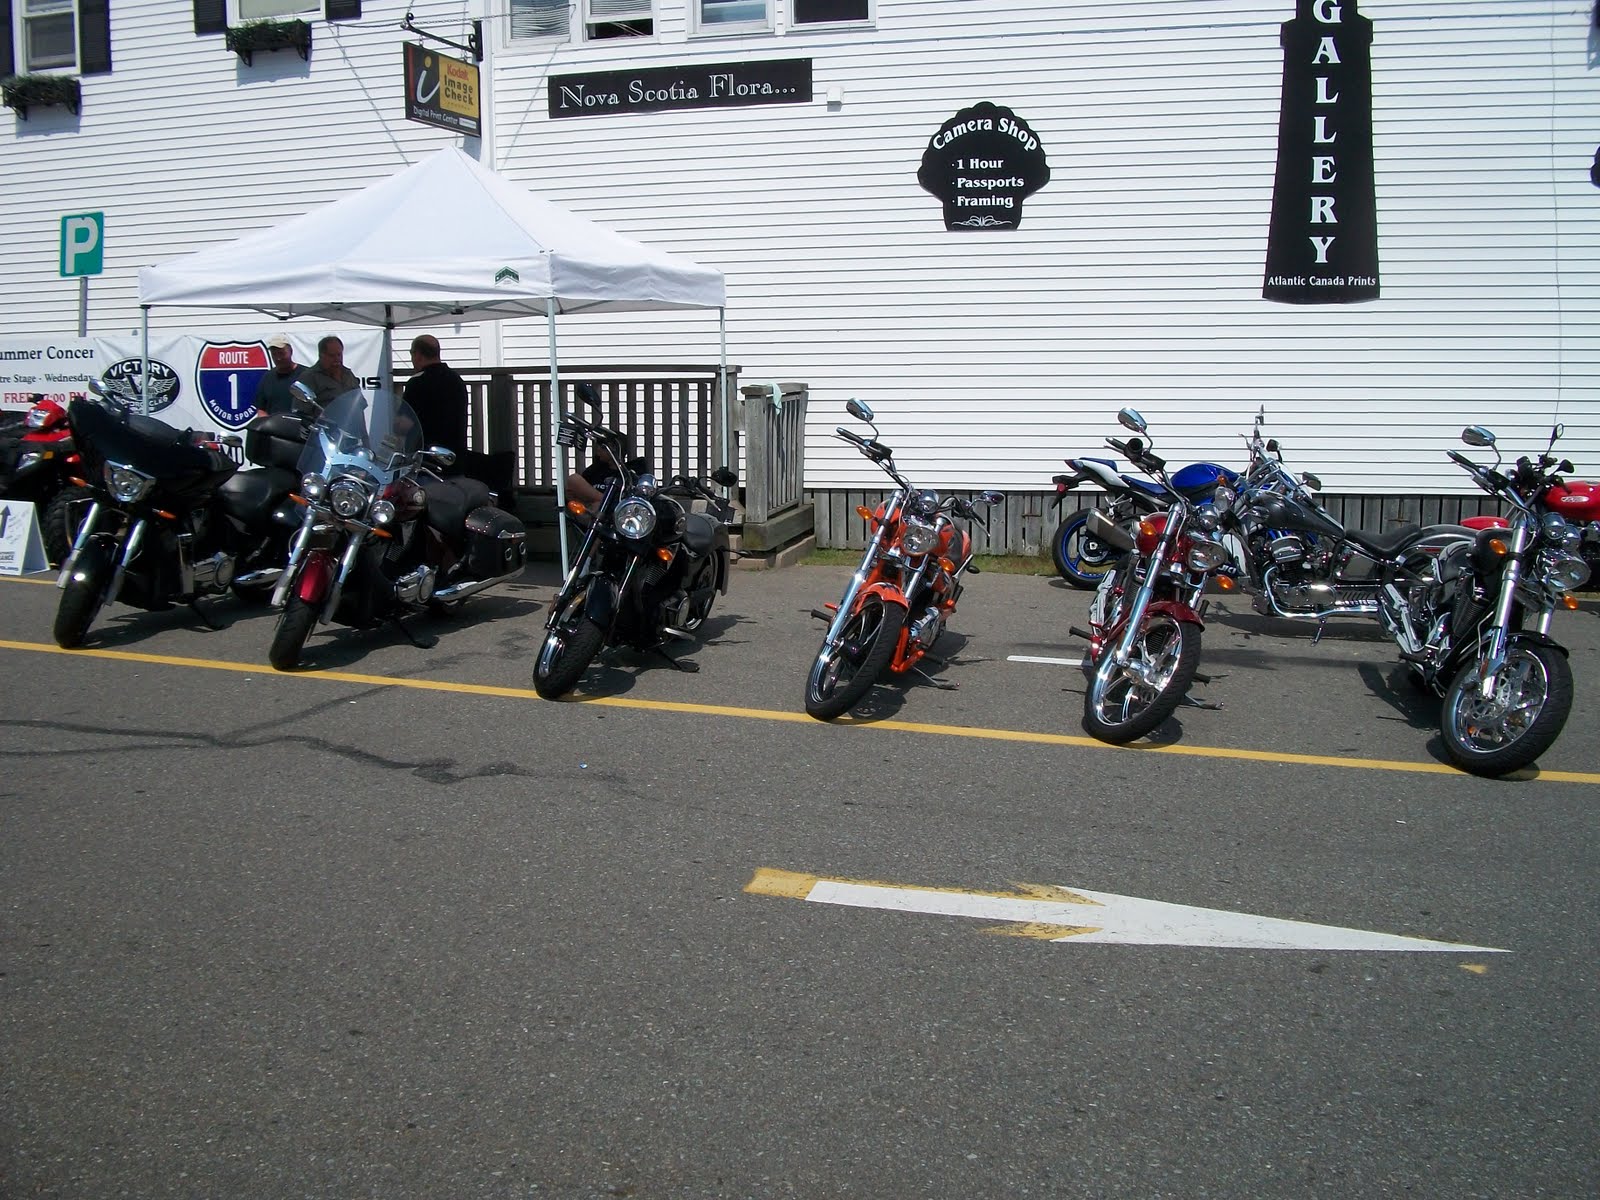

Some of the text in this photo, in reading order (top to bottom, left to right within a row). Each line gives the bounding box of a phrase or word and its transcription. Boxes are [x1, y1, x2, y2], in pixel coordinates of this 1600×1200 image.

[446, 63, 469, 81] Kodak
[444, 75, 473, 94] Image
[559, 73, 796, 108] Nova Scotia Flora...
[444, 87, 474, 106] Check
[413, 105, 430, 118] Digital
[430, 110, 442, 121] Print
[442, 113, 458, 124] Center
[932, 117, 1038, 151] Camera Shop
[1308, 0, 1342, 264] GALLERY
[969, 158, 1004, 169] Hour
[957, 176, 1025, 190] Passports
[957, 195, 1014, 208] Framing
[65, 216, 99, 274] P
[1267, 275, 1376, 286] Atlantic Canada Prints
[219, 351, 249, 364] ROUTE
[13, 374, 36, 384] Stage
[44, 373, 94, 383] Wednesday
[358, 376, 381, 390] IS
[228, 373, 238, 410] 1
[209, 399, 232, 421] MOTOR
